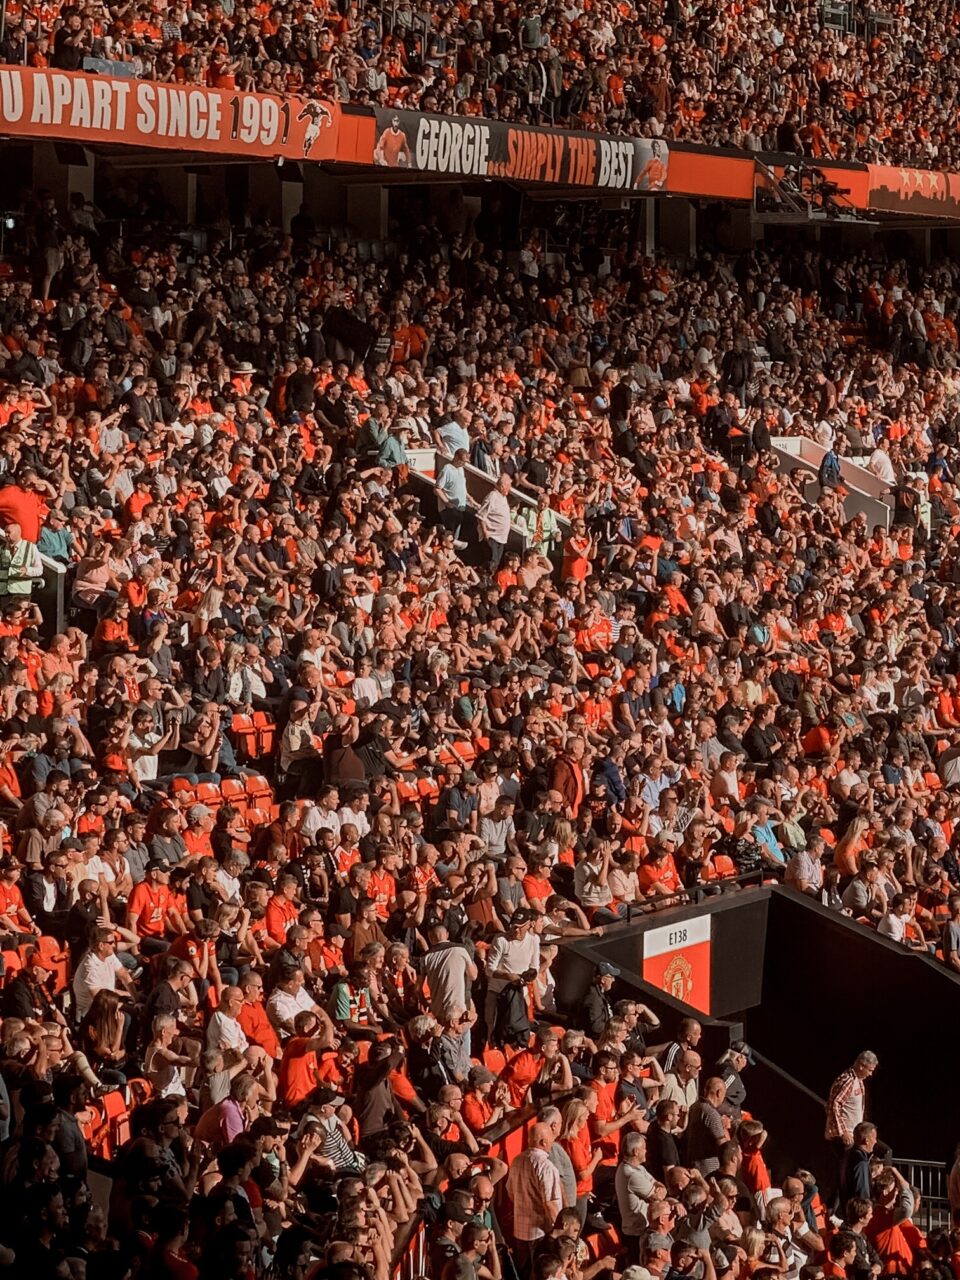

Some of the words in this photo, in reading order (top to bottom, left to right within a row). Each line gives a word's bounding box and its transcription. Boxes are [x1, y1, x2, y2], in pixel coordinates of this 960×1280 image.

[31, 72, 130, 131] APART
[136, 83, 221, 141] SINCE
[229, 95, 290, 146] 1991
[568, 136, 597, 186] THE
[598, 140, 634, 189] BEST
[669, 929, 688, 946] E138
